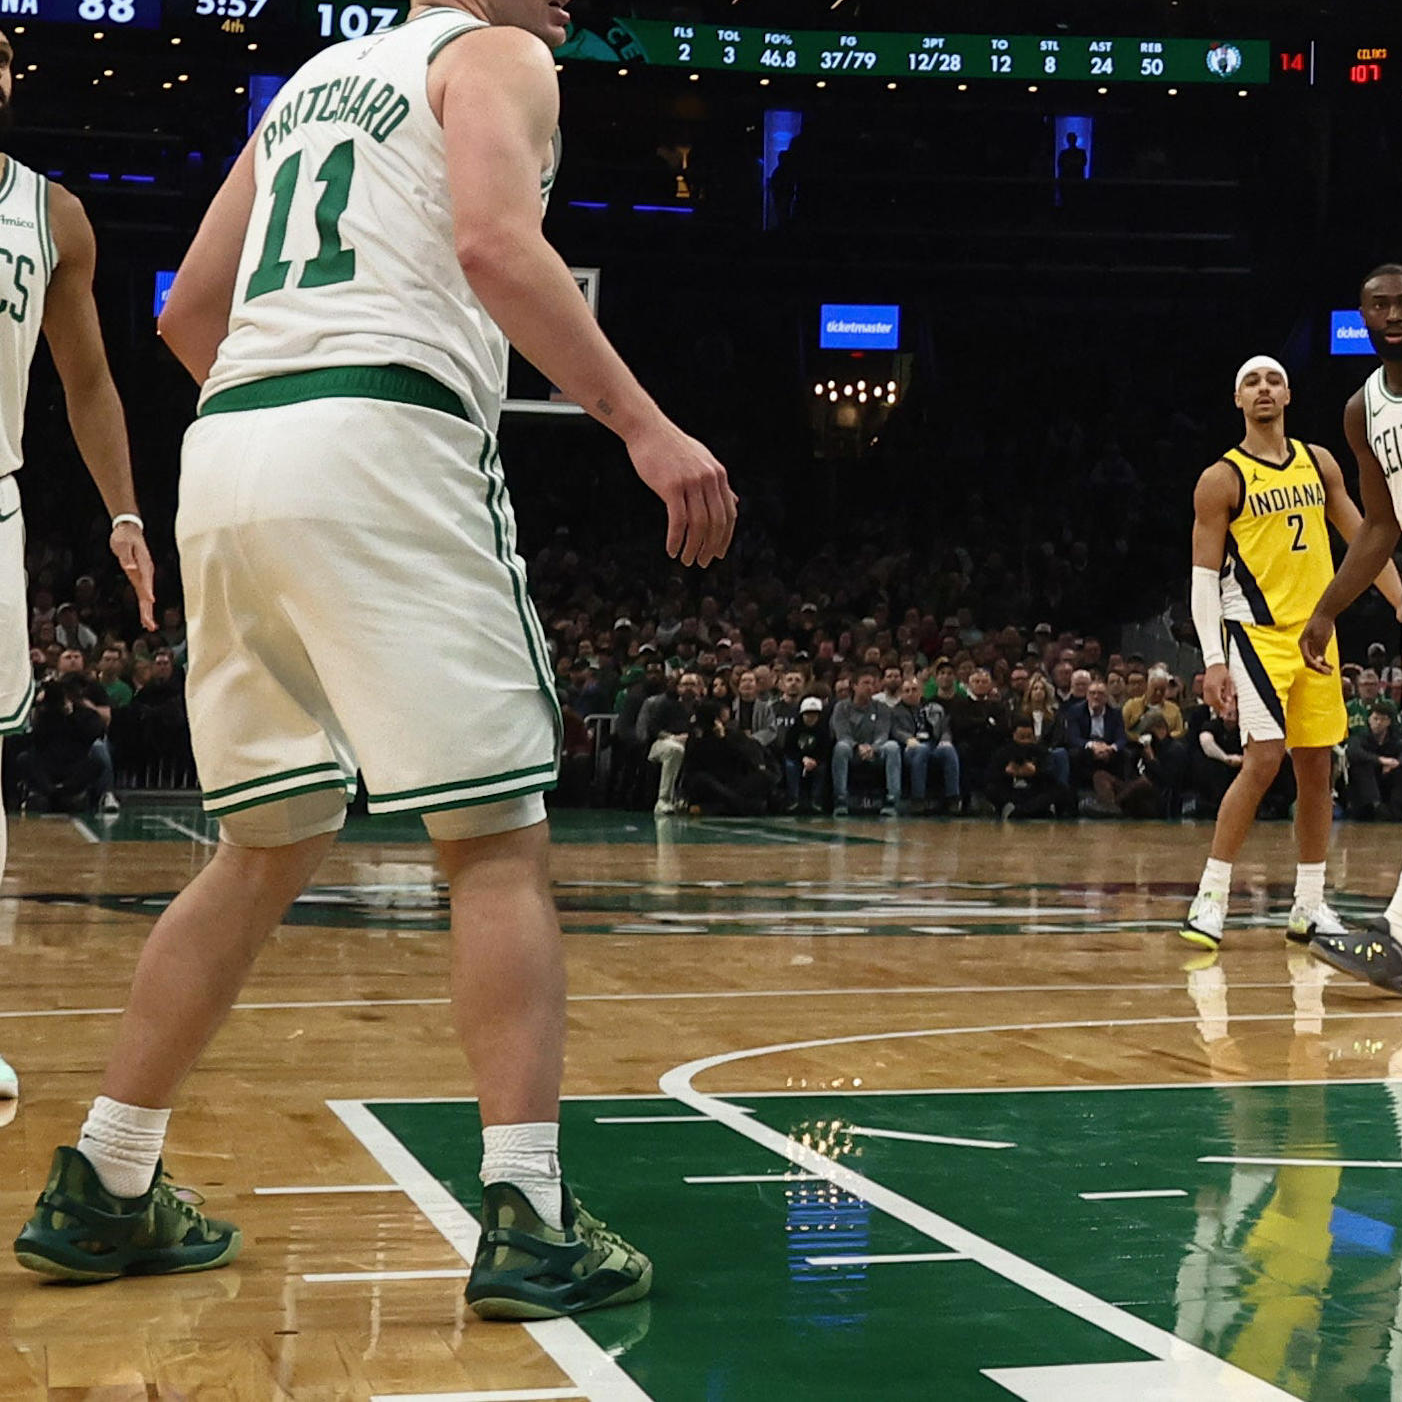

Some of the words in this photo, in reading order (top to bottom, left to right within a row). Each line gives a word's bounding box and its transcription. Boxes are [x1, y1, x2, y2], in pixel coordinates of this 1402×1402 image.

[221, 19, 246, 34] 4th
[673, 26, 694, 39] FLS
[717, 30, 741, 43] TOL
[764, 32, 793, 46] FG%
[840, 35, 858, 47] FG
[922, 37, 946, 49] 3PT
[991, 38, 1009, 50] TO
[1040, 40, 1060, 52] STL
[1089, 41, 1113, 53] AST
[1140, 42, 1163, 54] REB
[678, 43, 691, 62] 2
[723, 46, 736, 64] 3
[760, 49, 796, 68] 46.8
[820, 51, 877, 71] 37/79
[908, 52, 962, 73] 12/28
[990, 54, 1012, 73] 12
[1044, 56, 1057, 74] 8
[1090, 57, 1113, 75] 24
[1140, 58, 1164, 76] 50
[1281, 53, 1305, 71] 14
[1350, 64, 1380, 83] 107
[263, 75, 410, 160] PRITCHARD
[244, 138, 356, 304] 11
[826, 319, 894, 335] ticketmaster
[1248, 483, 1325, 518] INDIANA
[1287, 513, 1308, 552] 2
